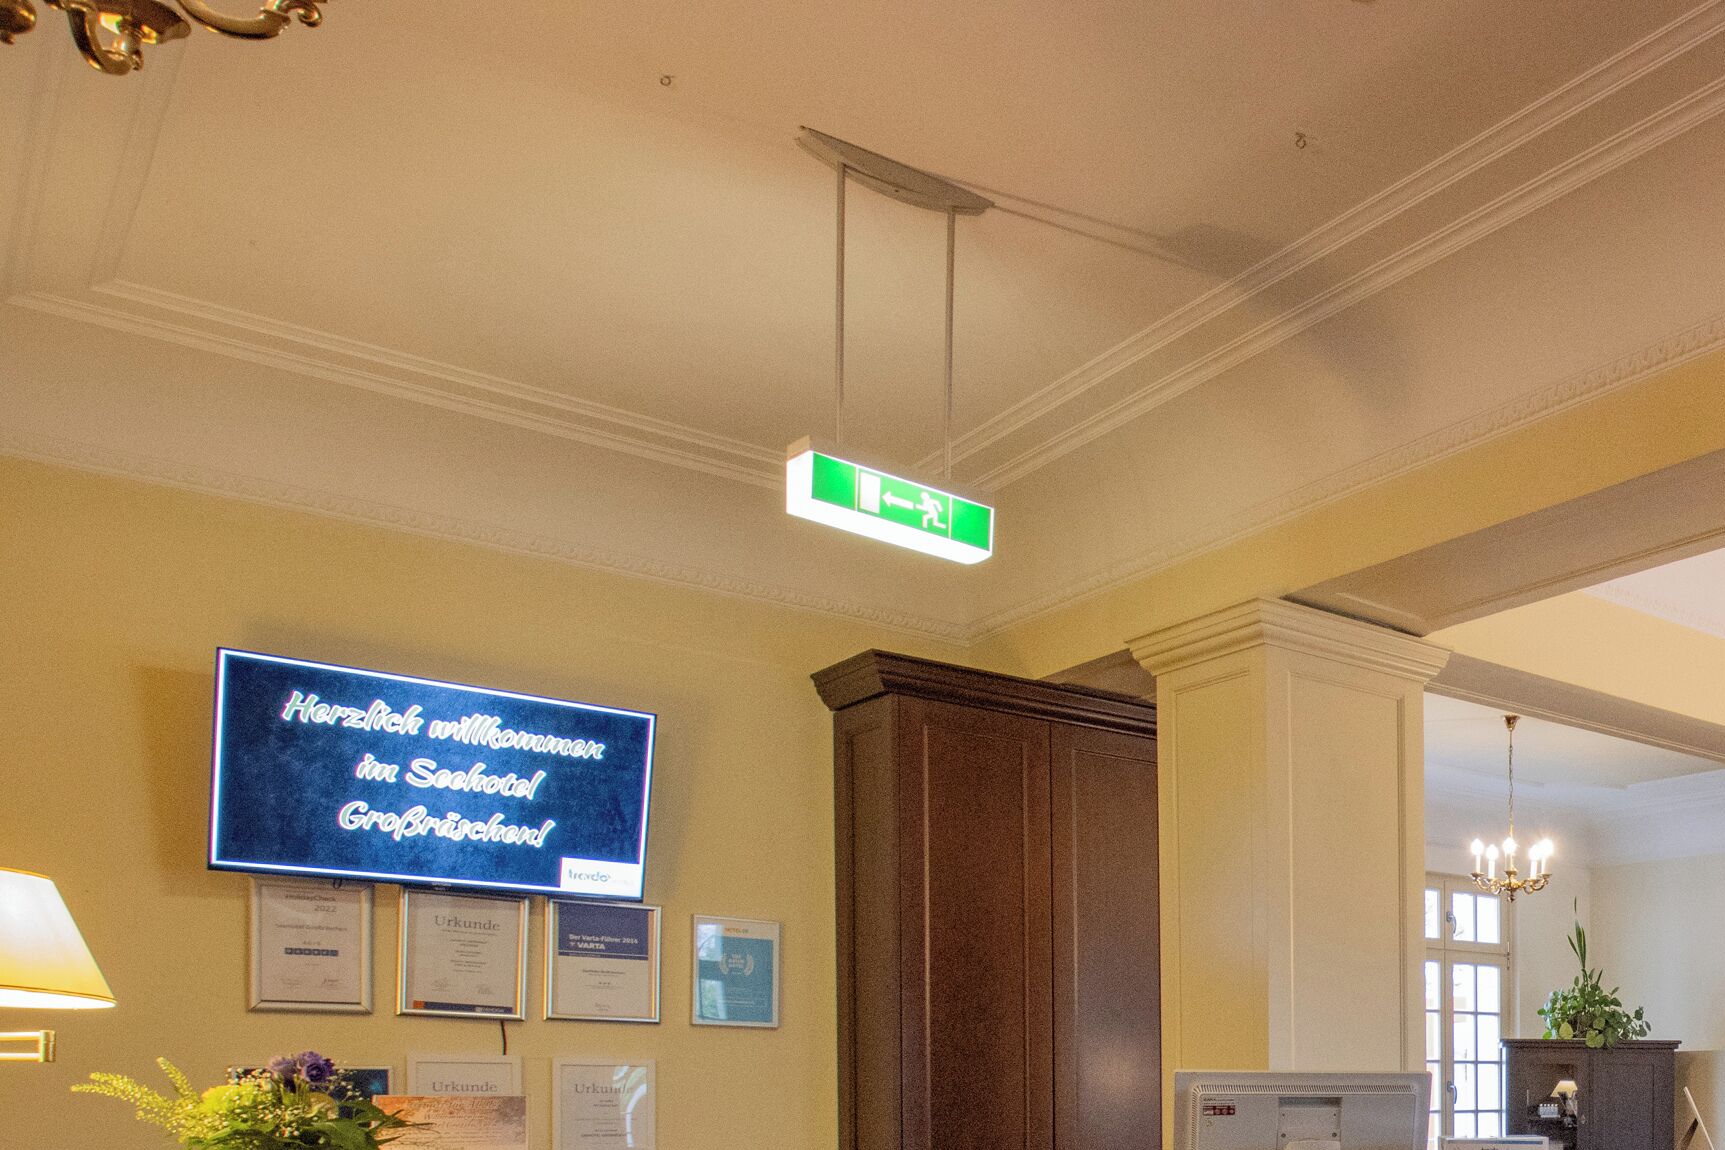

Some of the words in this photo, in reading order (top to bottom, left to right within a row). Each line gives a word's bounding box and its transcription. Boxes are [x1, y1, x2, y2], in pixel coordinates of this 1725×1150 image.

[282, 690, 425, 735] Herzlich
[428, 714, 606, 760] willkommen
[355, 753, 398, 783] im
[404, 757, 546, 800] Seehotel
[338, 800, 556, 848] Großräschen!
[434, 915, 501, 931] Urkunde
[577, 942, 605, 950] VARTA
[432, 1081, 498, 1093] Urkunde
[574, 1083, 633, 1094] Urkund
